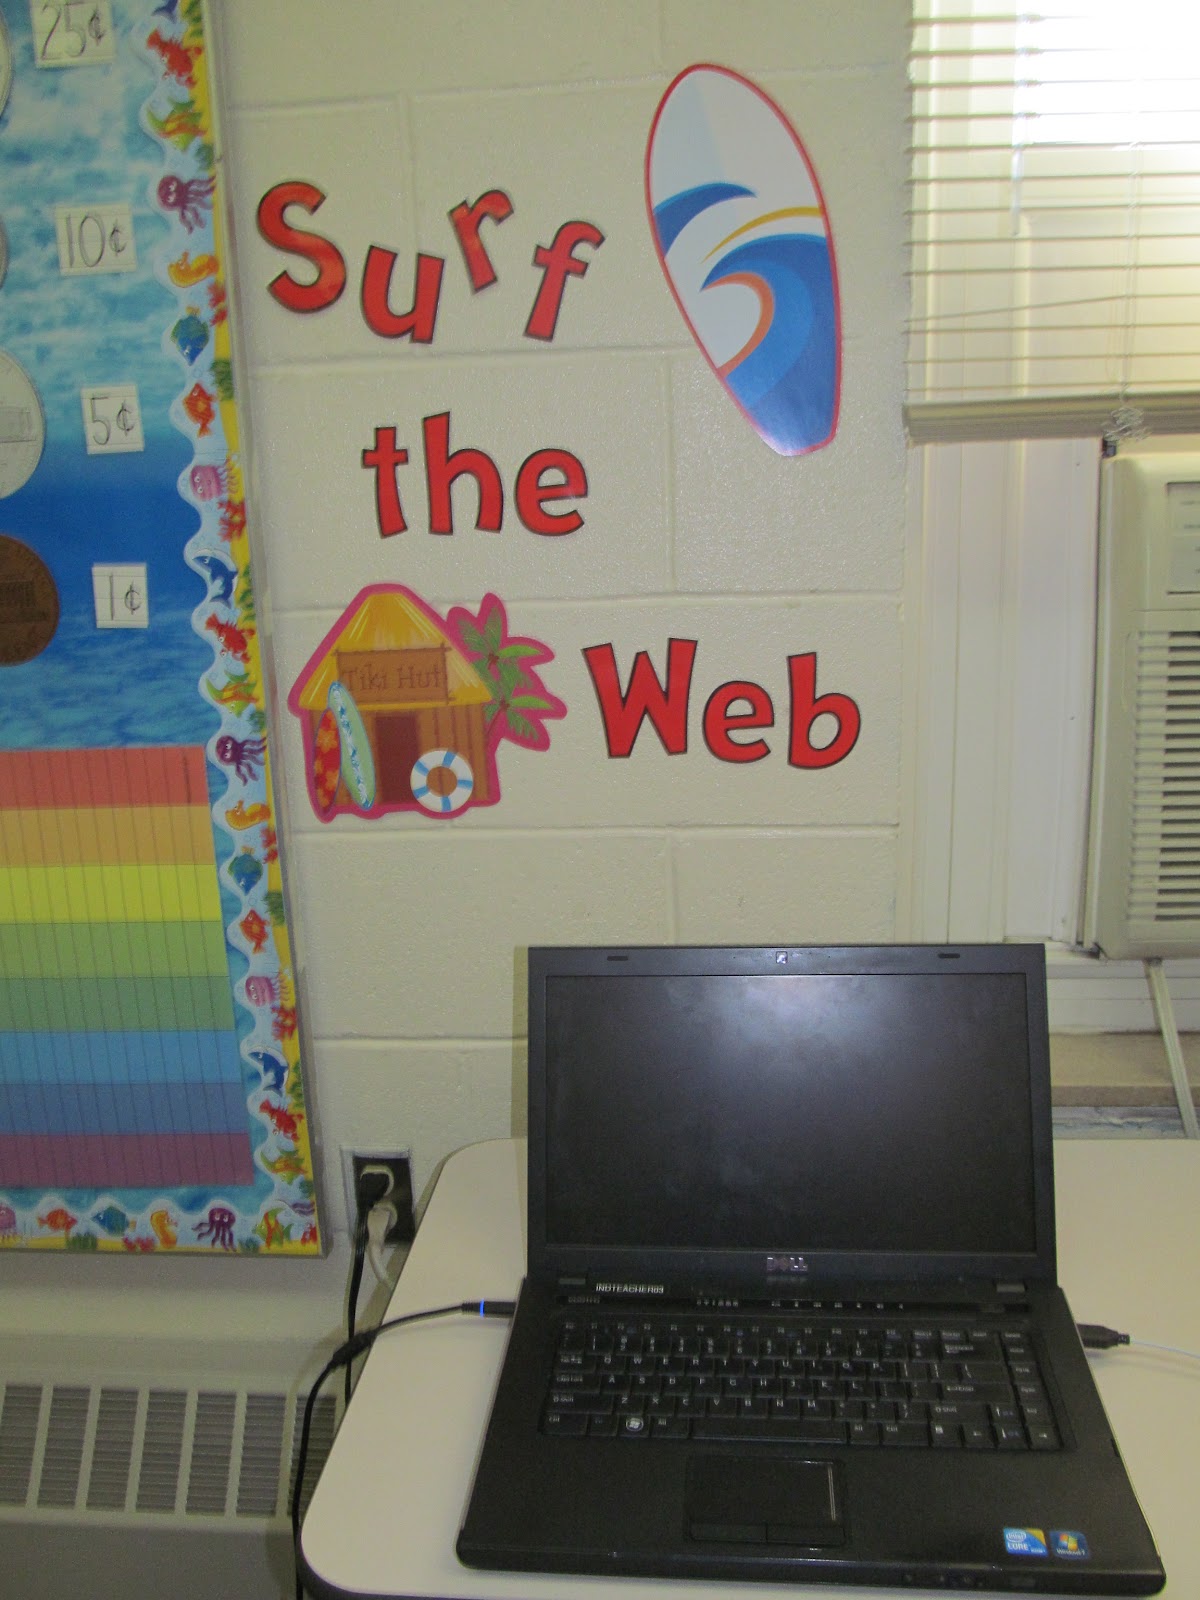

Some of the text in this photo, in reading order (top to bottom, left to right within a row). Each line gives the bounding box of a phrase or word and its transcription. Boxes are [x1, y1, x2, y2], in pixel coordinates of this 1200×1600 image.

[40, 2, 108, 60] 25¢
[65, 213, 128, 269] 10¢
[257, 181, 606, 344] Surf
[89, 396, 136, 446] 5¢
[361, 411, 589, 539] the
[108, 574, 142, 621] 1¢
[341, 664, 441, 692] Tiki Hut
[581, 637, 862, 770] Web
